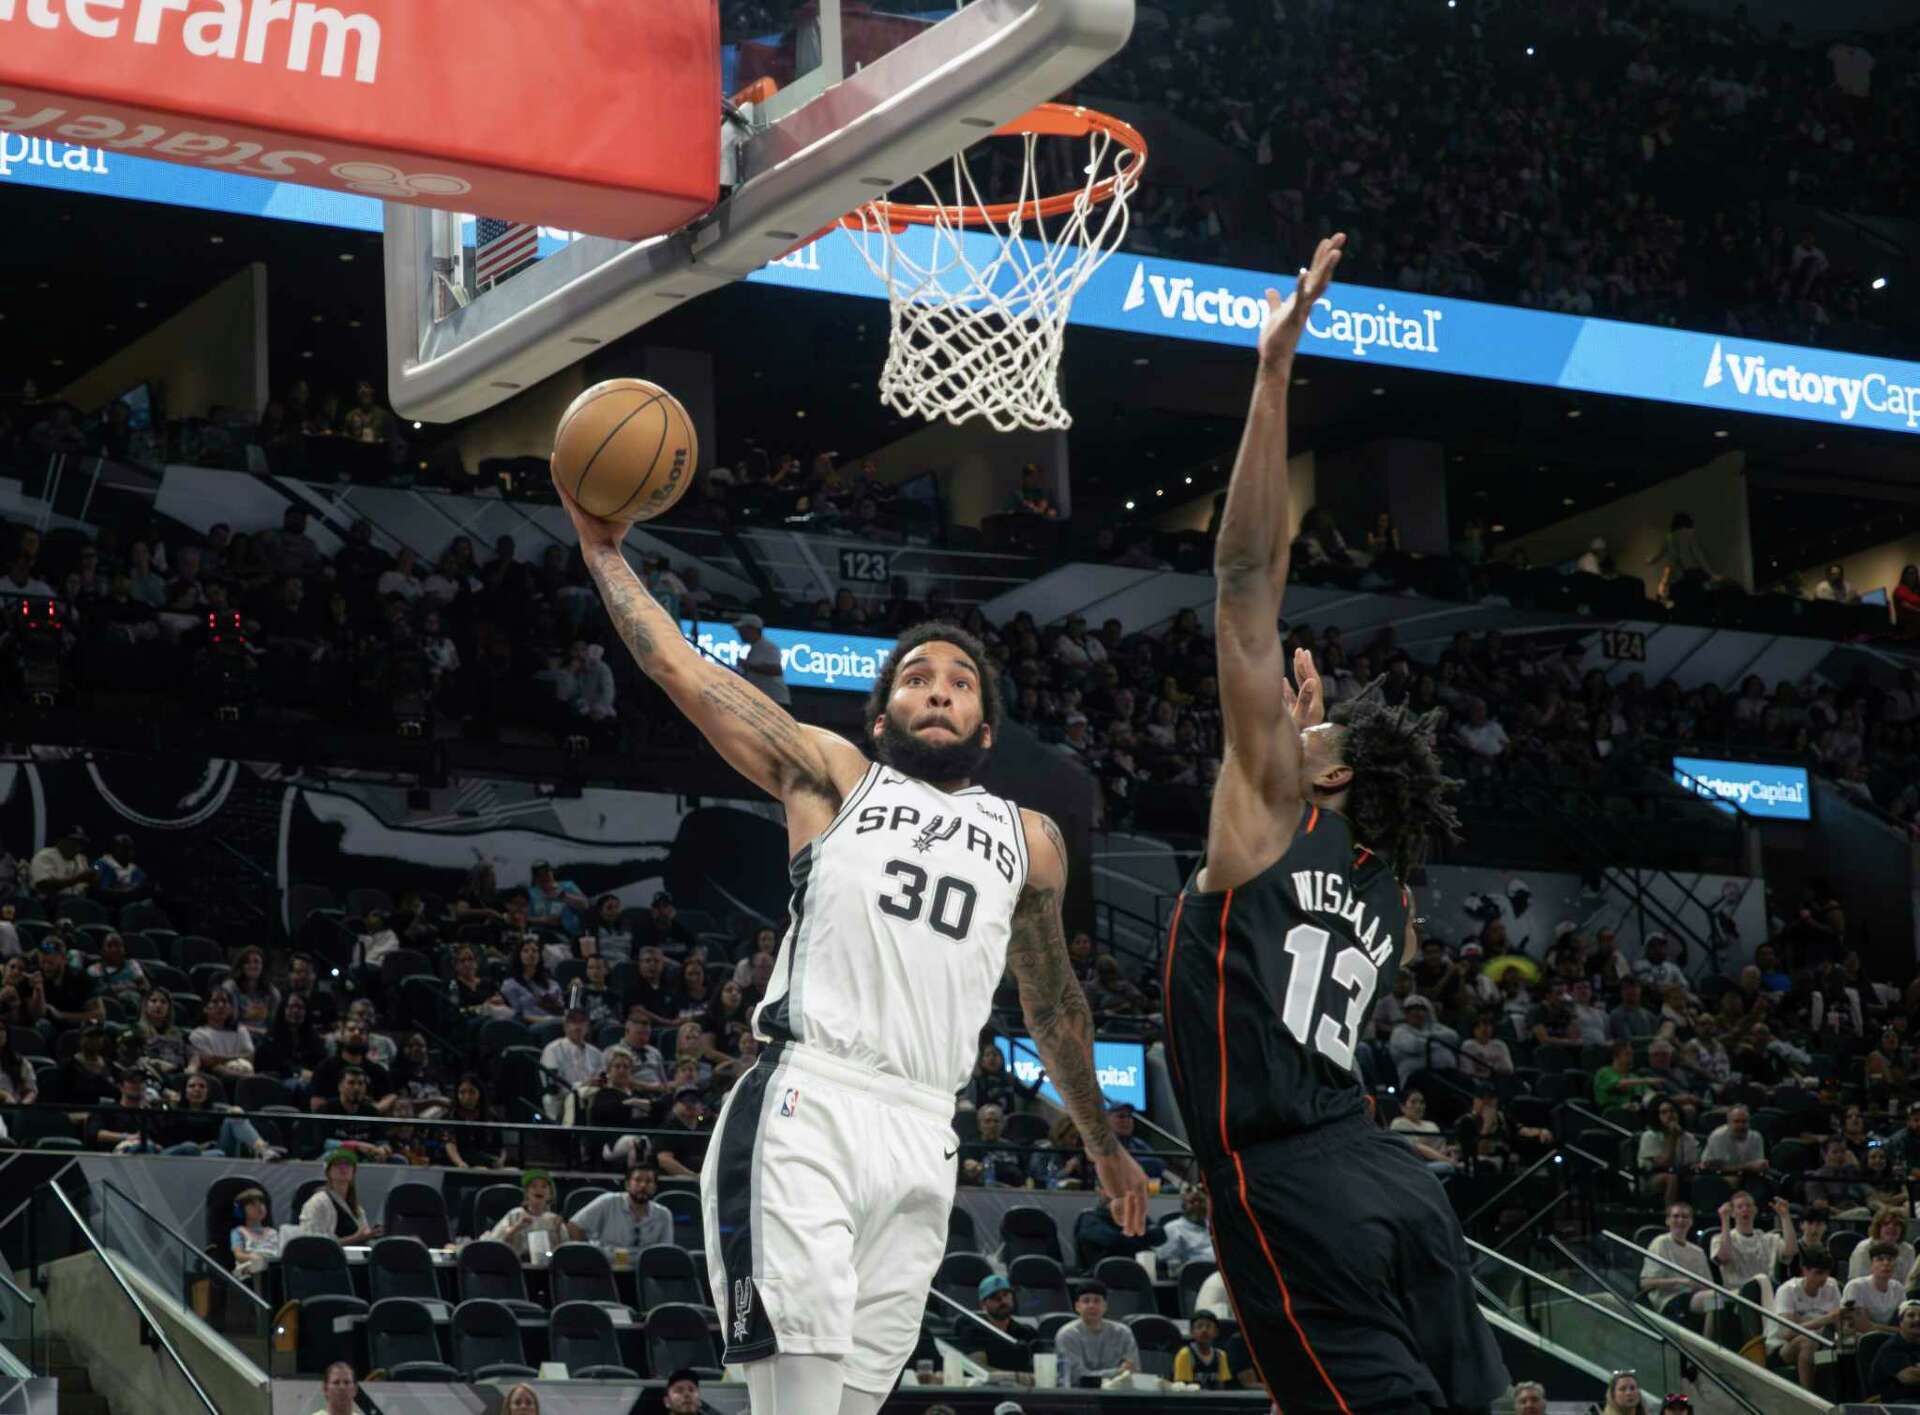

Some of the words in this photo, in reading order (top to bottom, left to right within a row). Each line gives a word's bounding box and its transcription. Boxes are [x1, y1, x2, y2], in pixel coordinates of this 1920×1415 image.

[842, 551, 887, 581] 123
[1604, 632, 1644, 660] 124
[856, 805, 1016, 884] SPURS
[876, 857, 979, 942] 30
[1282, 923, 1378, 1071] 13
